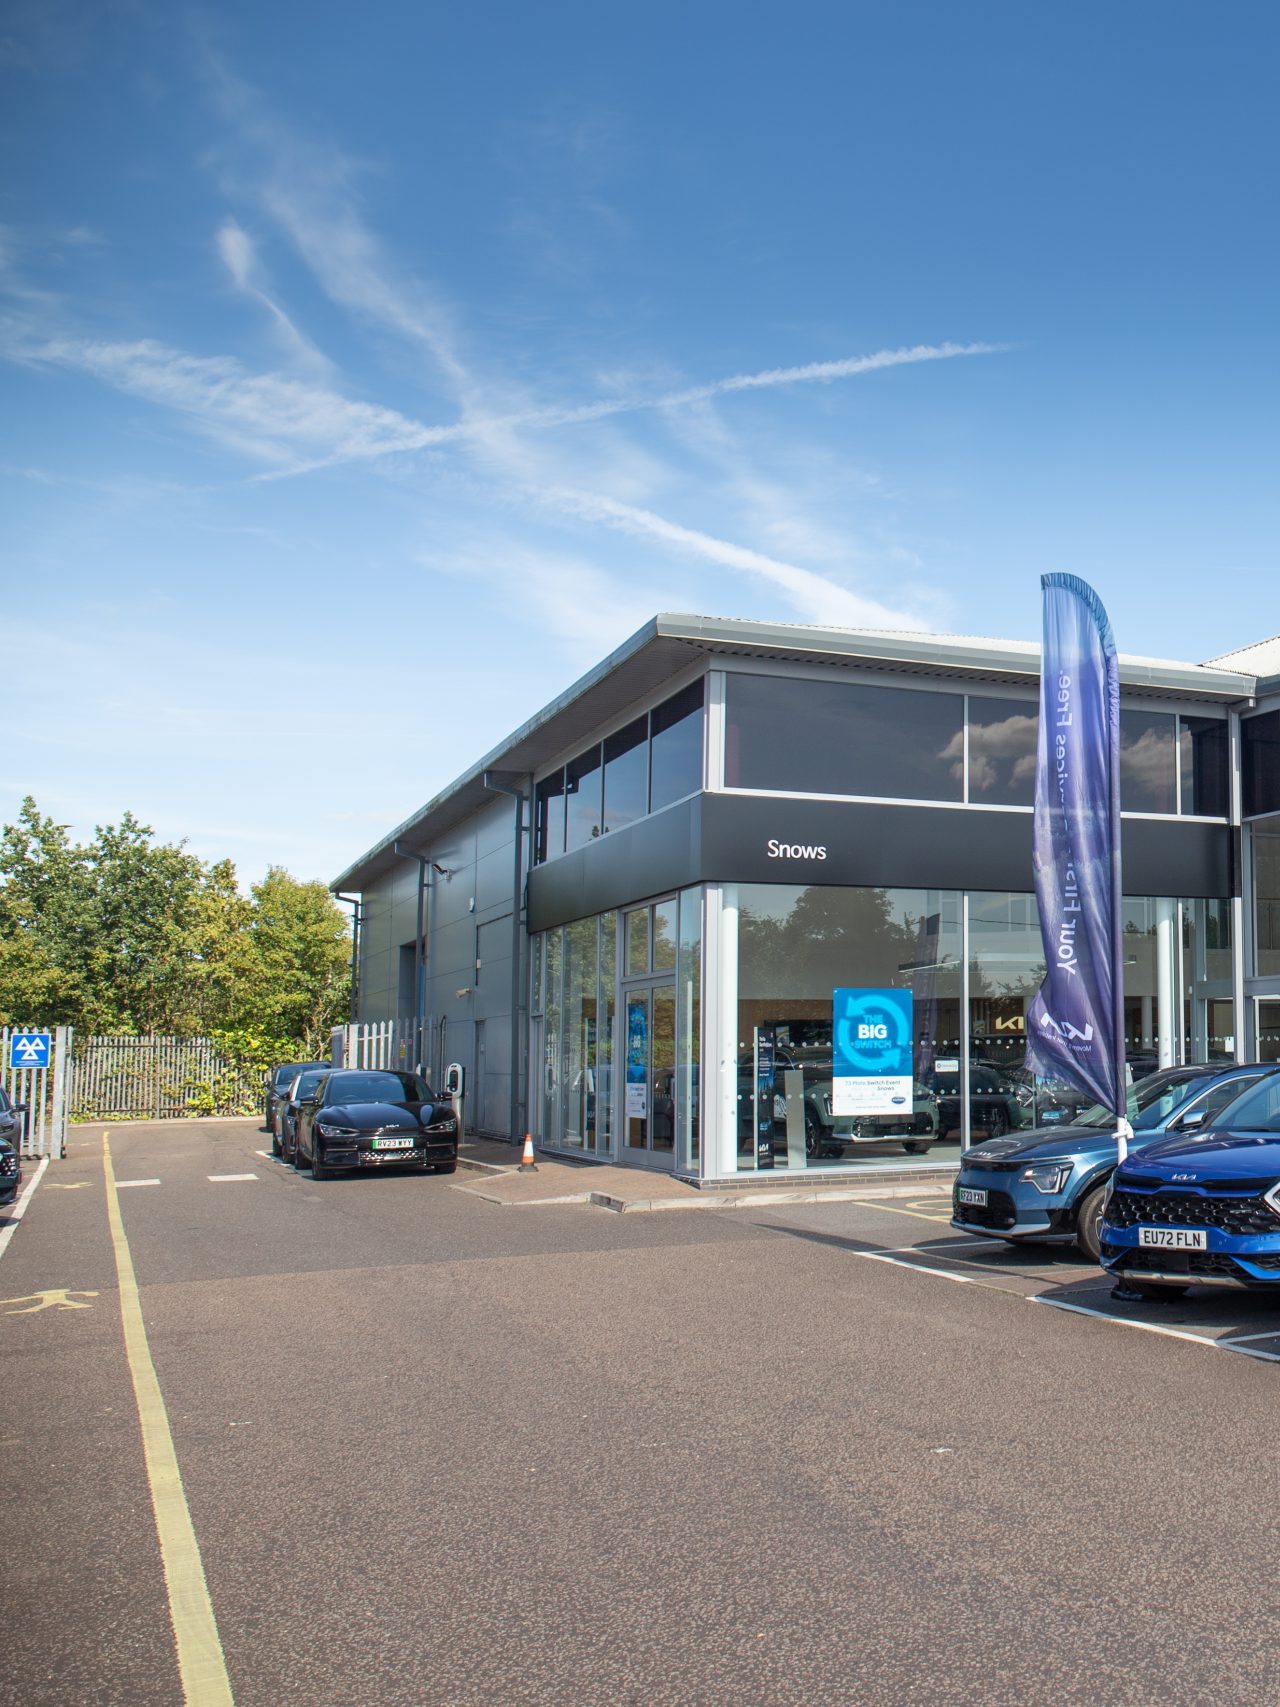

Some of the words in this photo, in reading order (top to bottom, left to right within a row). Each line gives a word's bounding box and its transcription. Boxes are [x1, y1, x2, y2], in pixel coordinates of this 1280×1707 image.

[767, 839, 827, 860] Snows
[863, 1014, 884, 1024] THE
[996, 1016, 1025, 1030] KI
[858, 1024, 888, 1039] BIG
[854, 1039, 892, 1049] SWITCH
[1143, 1230, 1174, 1246] EU72
[1176, 1231, 1201, 1247] FLN
